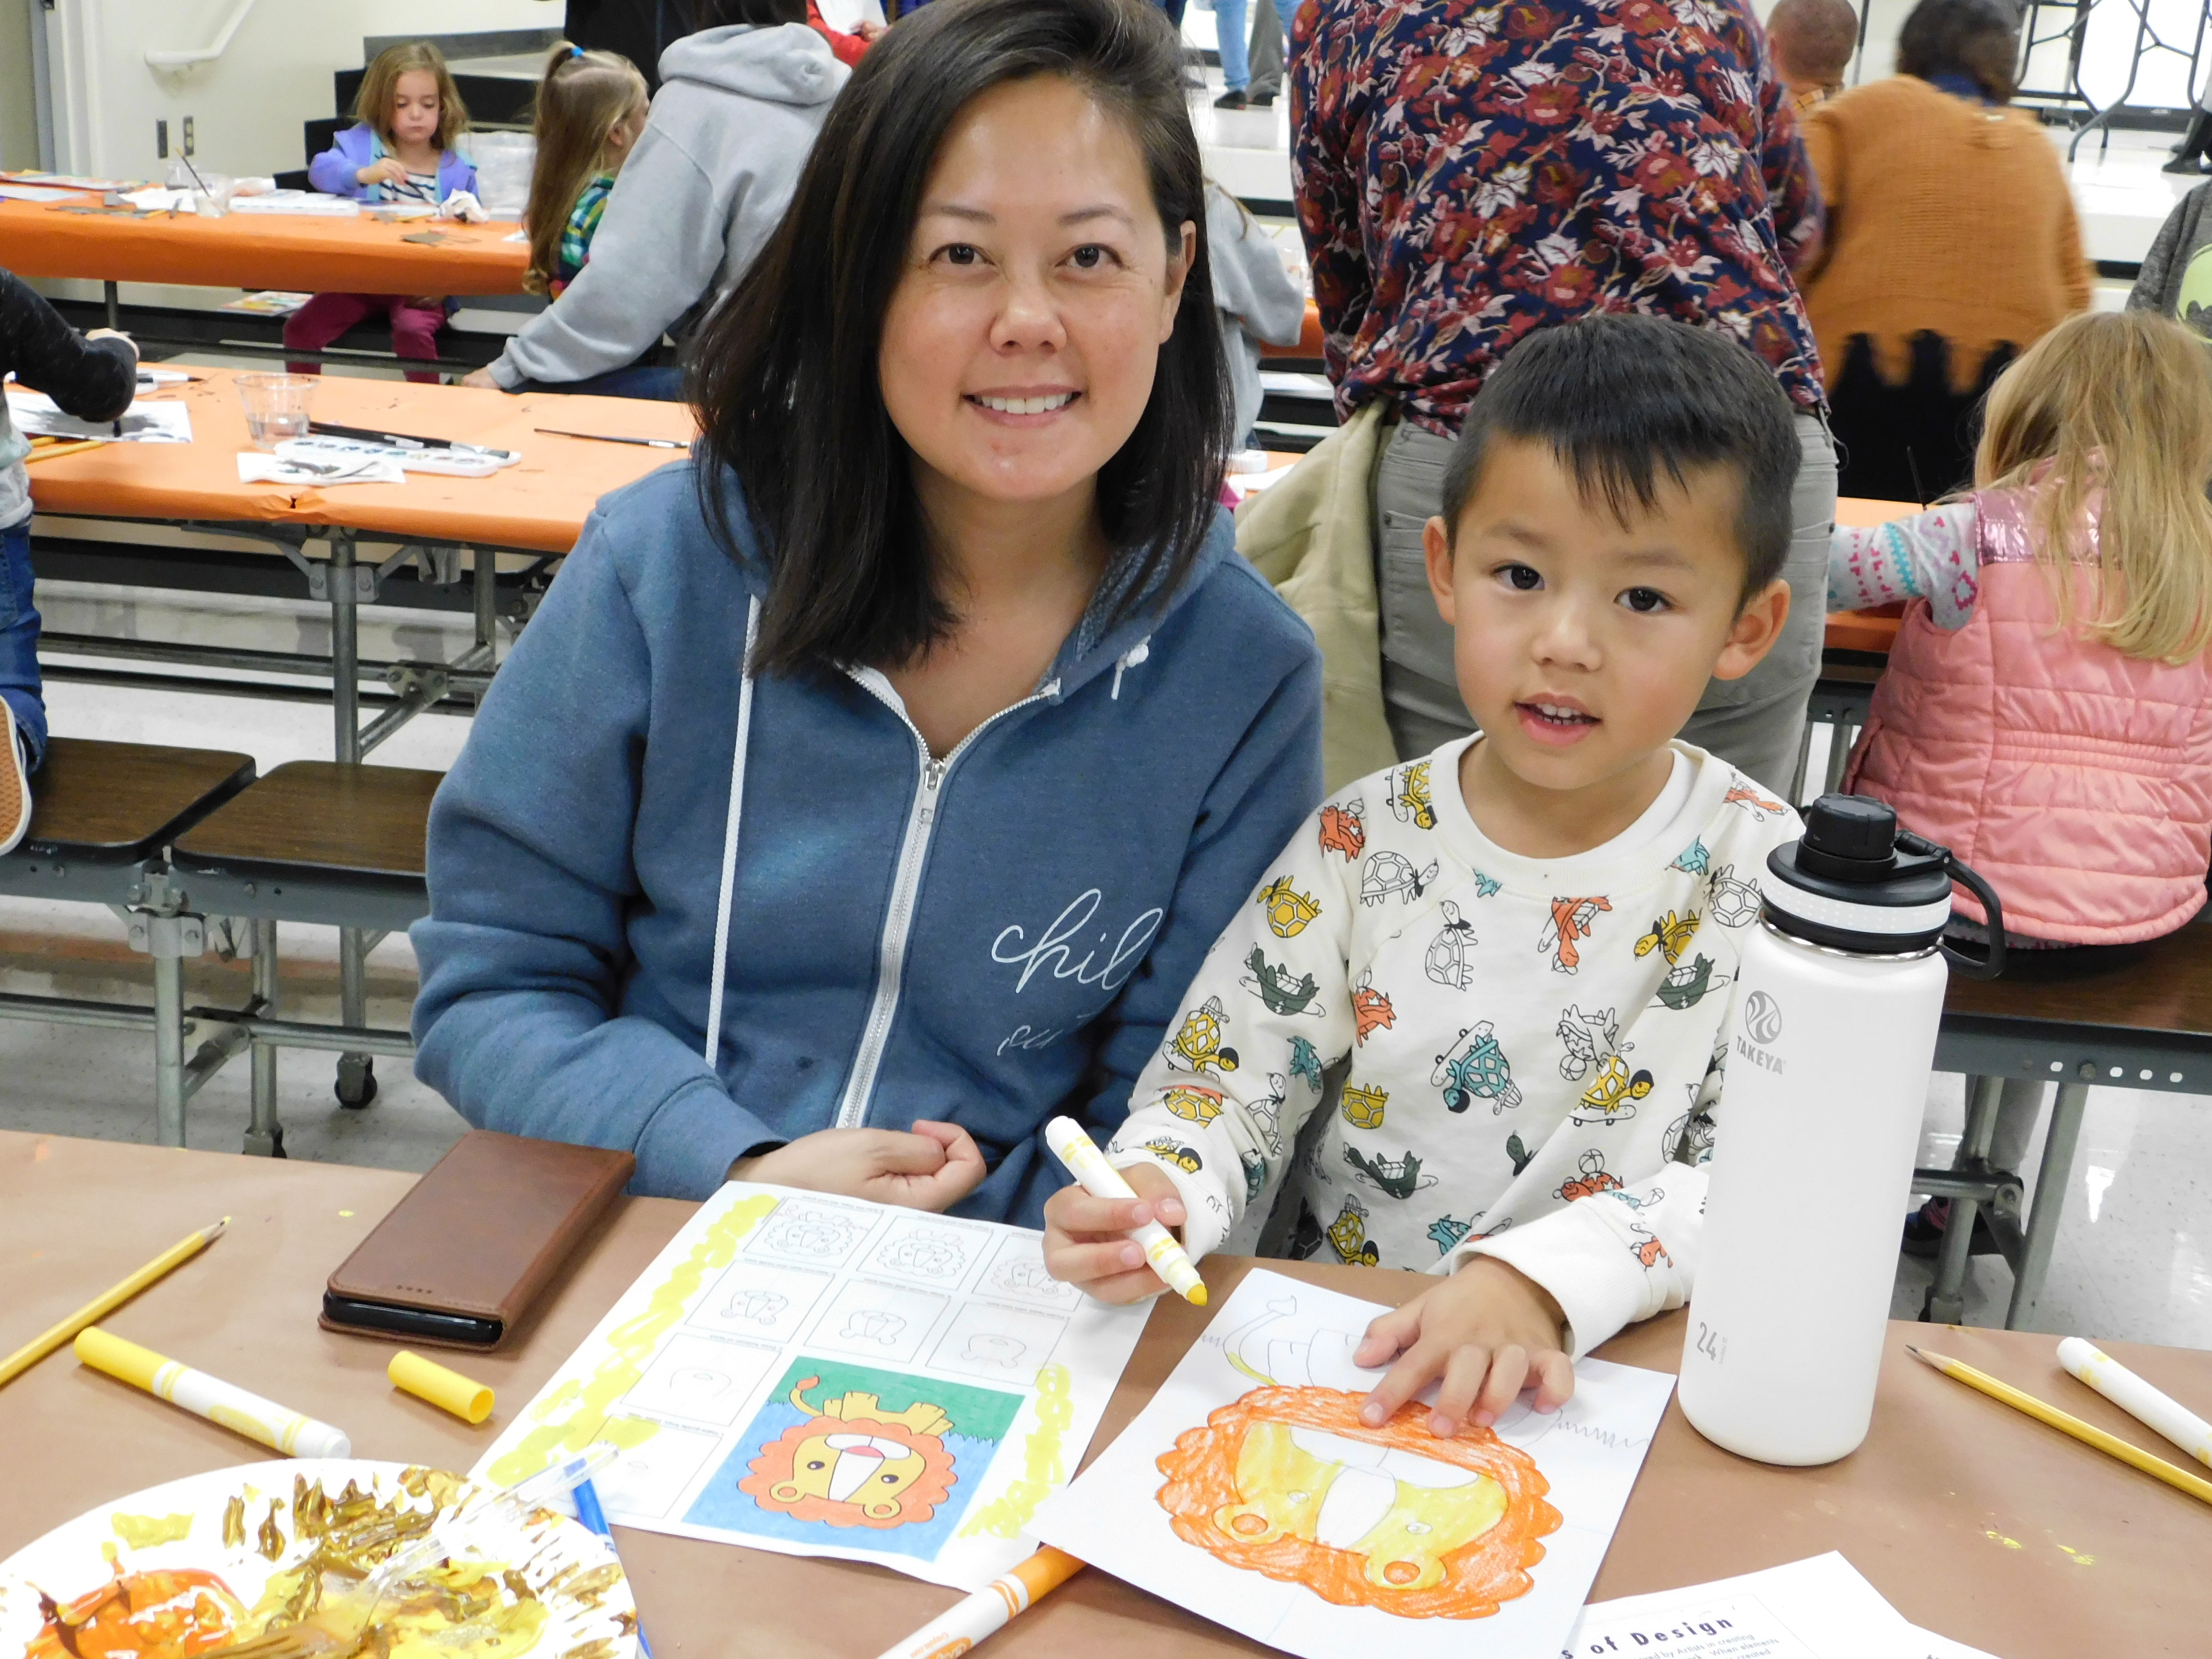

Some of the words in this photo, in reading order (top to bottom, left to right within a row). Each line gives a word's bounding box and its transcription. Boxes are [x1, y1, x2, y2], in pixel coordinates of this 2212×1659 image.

[991, 888, 1164, 994] chil
[1737, 1035, 1783, 1075] TAKEYA
[1696, 1321, 1717, 1361] 24
[1590, 1636, 1619, 1654] of
[1630, 1619, 1734, 1646] Design
[1677, 1644, 1705, 1655] Artists
[1718, 1634, 1755, 1646] creating
[1709, 1647, 1739, 1656] When
[1740, 1639, 1779, 1650] elements
